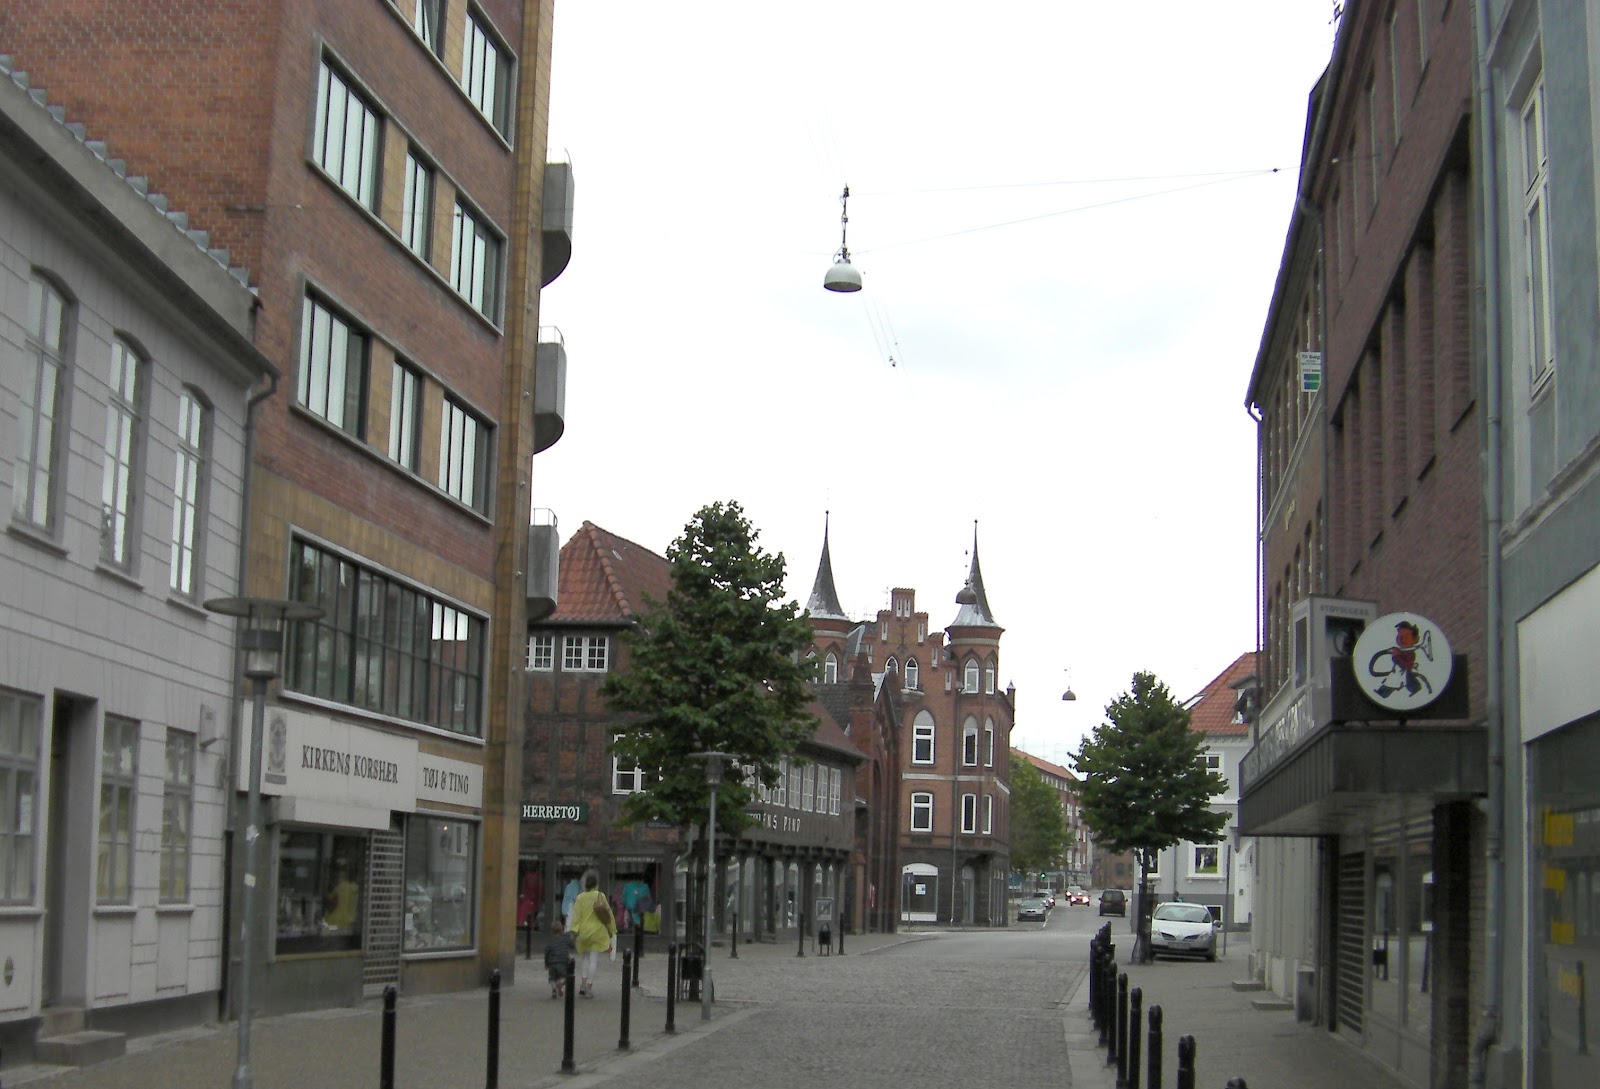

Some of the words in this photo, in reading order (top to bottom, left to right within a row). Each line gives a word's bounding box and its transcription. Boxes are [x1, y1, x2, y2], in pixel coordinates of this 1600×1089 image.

[302, 745, 351, 775] KIRKENS
[353, 754, 399, 784] KORSHÆR
[422, 767, 438, 789] TØJ
[440, 770, 447, 790] &
[449, 772, 469, 795] TING
[523, 805, 580, 822] HERRETØJ
